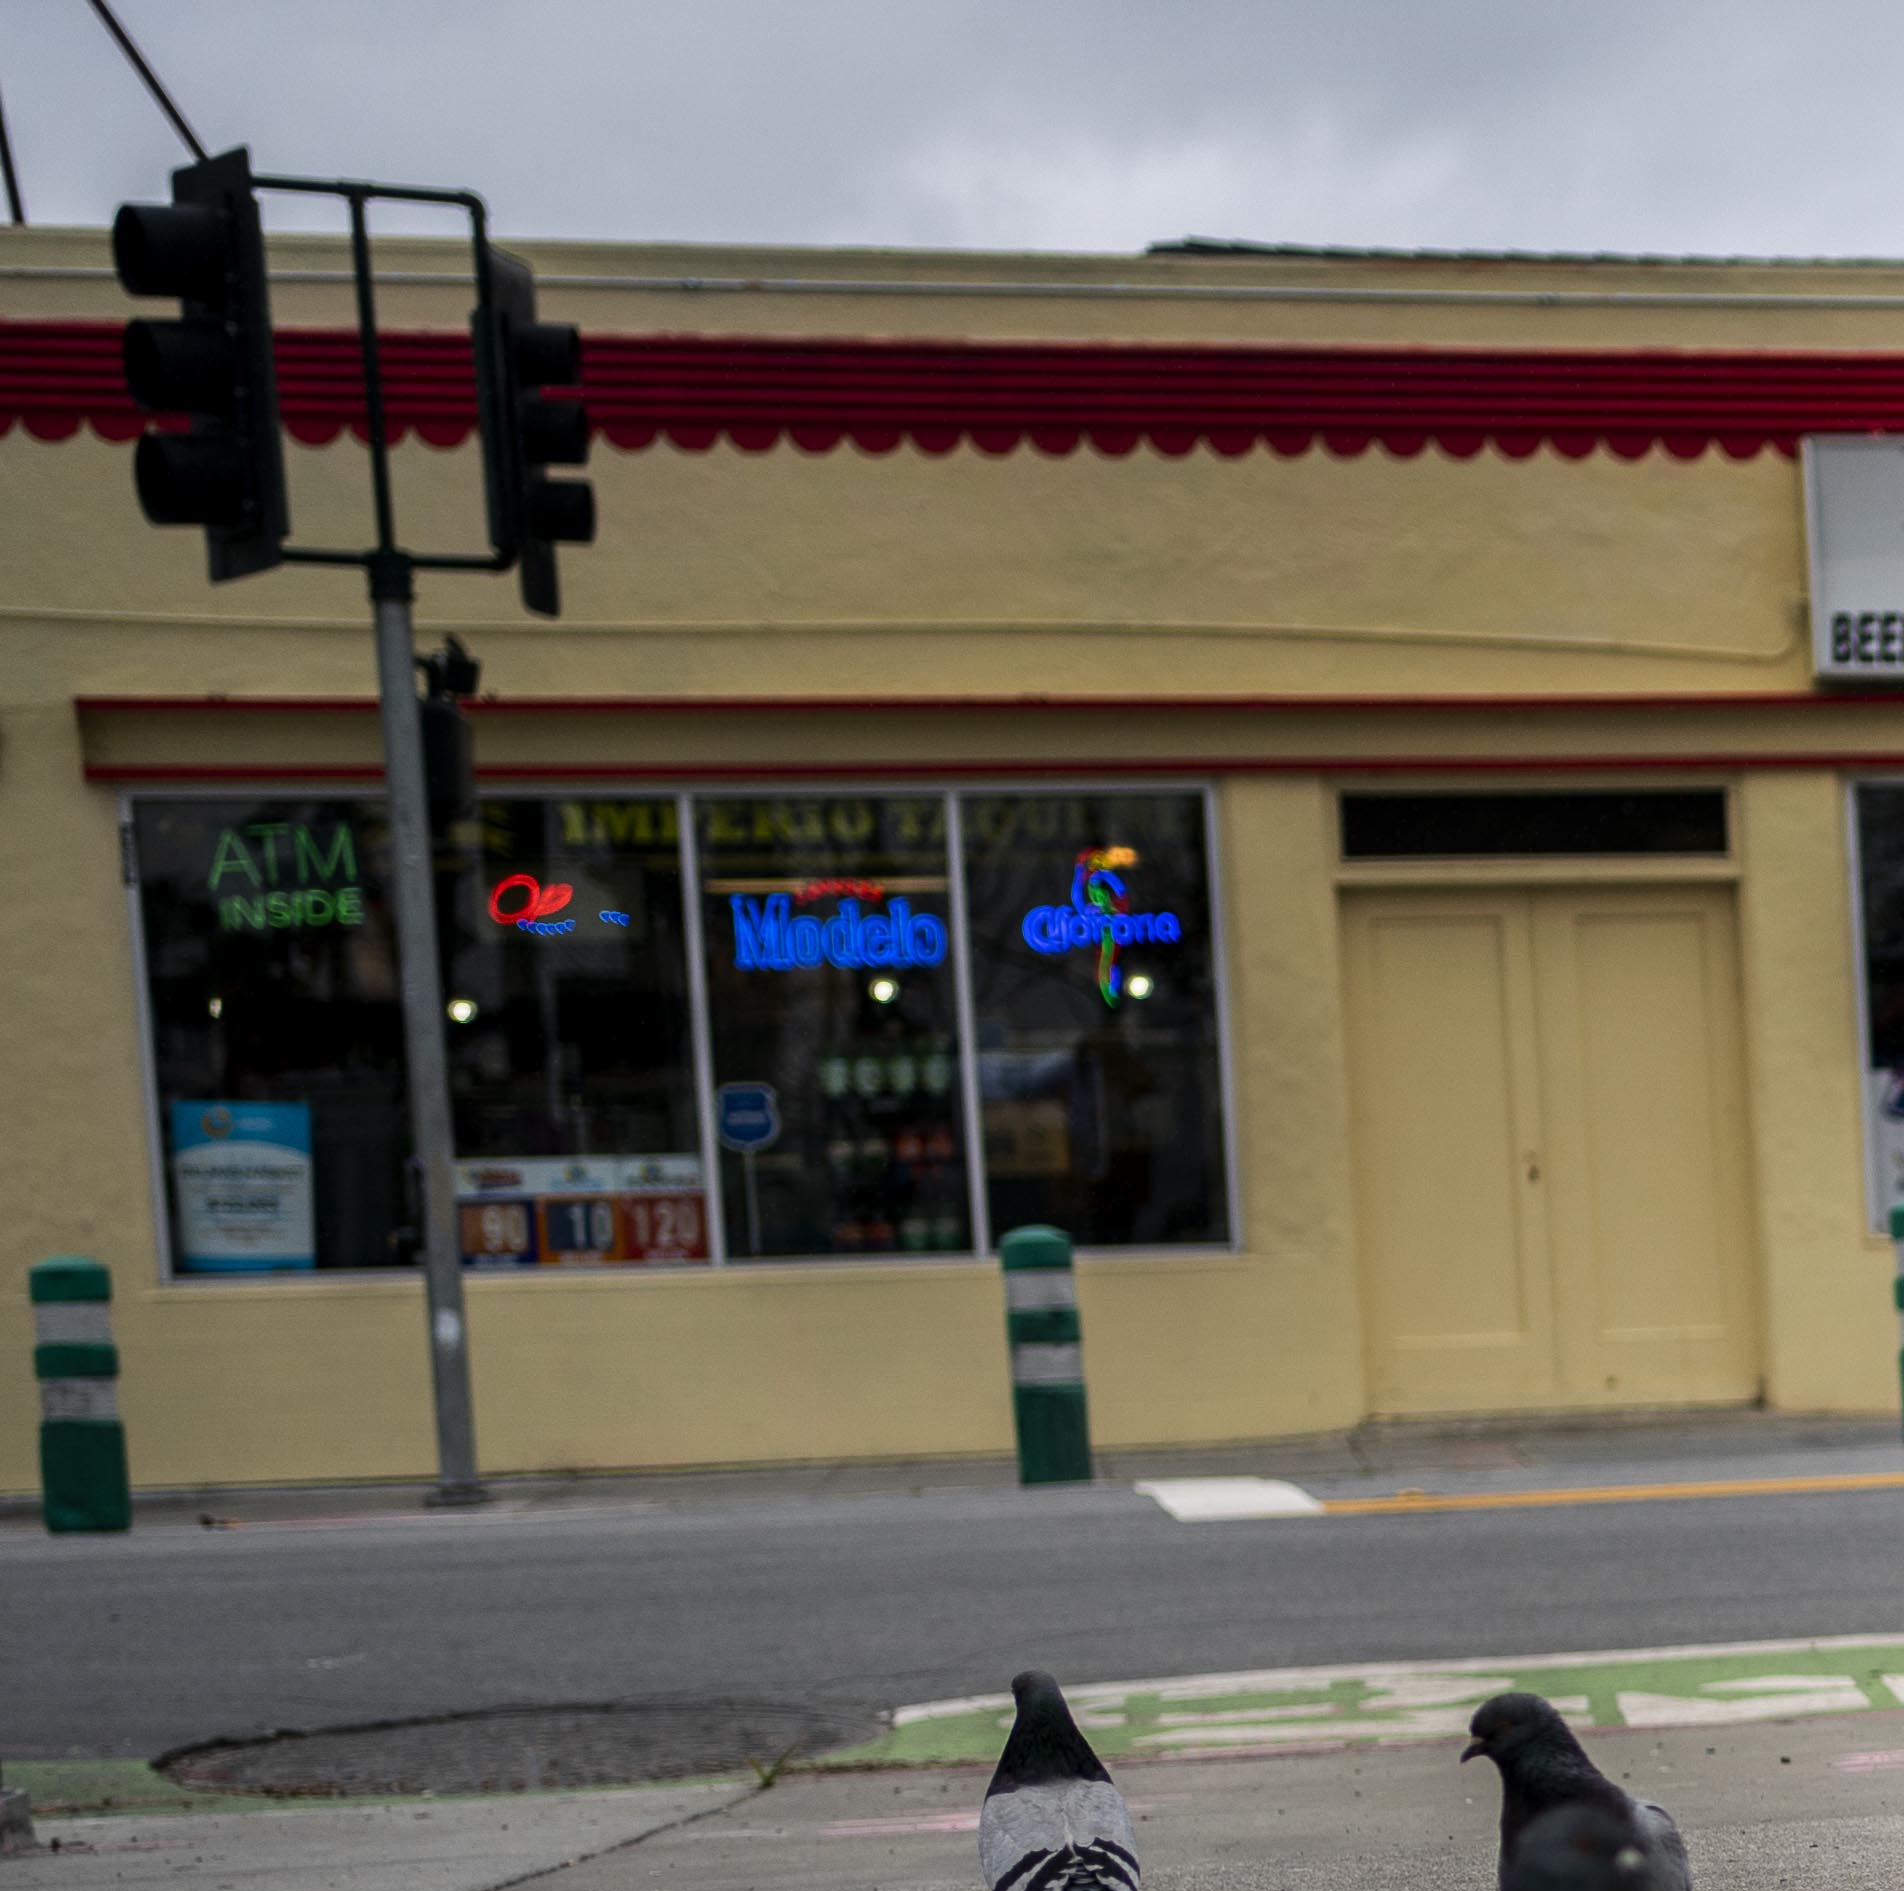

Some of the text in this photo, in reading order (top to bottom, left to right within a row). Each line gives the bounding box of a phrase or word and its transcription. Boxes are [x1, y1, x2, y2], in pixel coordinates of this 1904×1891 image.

[207, 824, 359, 891] ATM
[219, 887, 365, 930] INSIDE
[730, 891, 948, 972] Modelo
[1021, 904, 1182, 955] Corona
